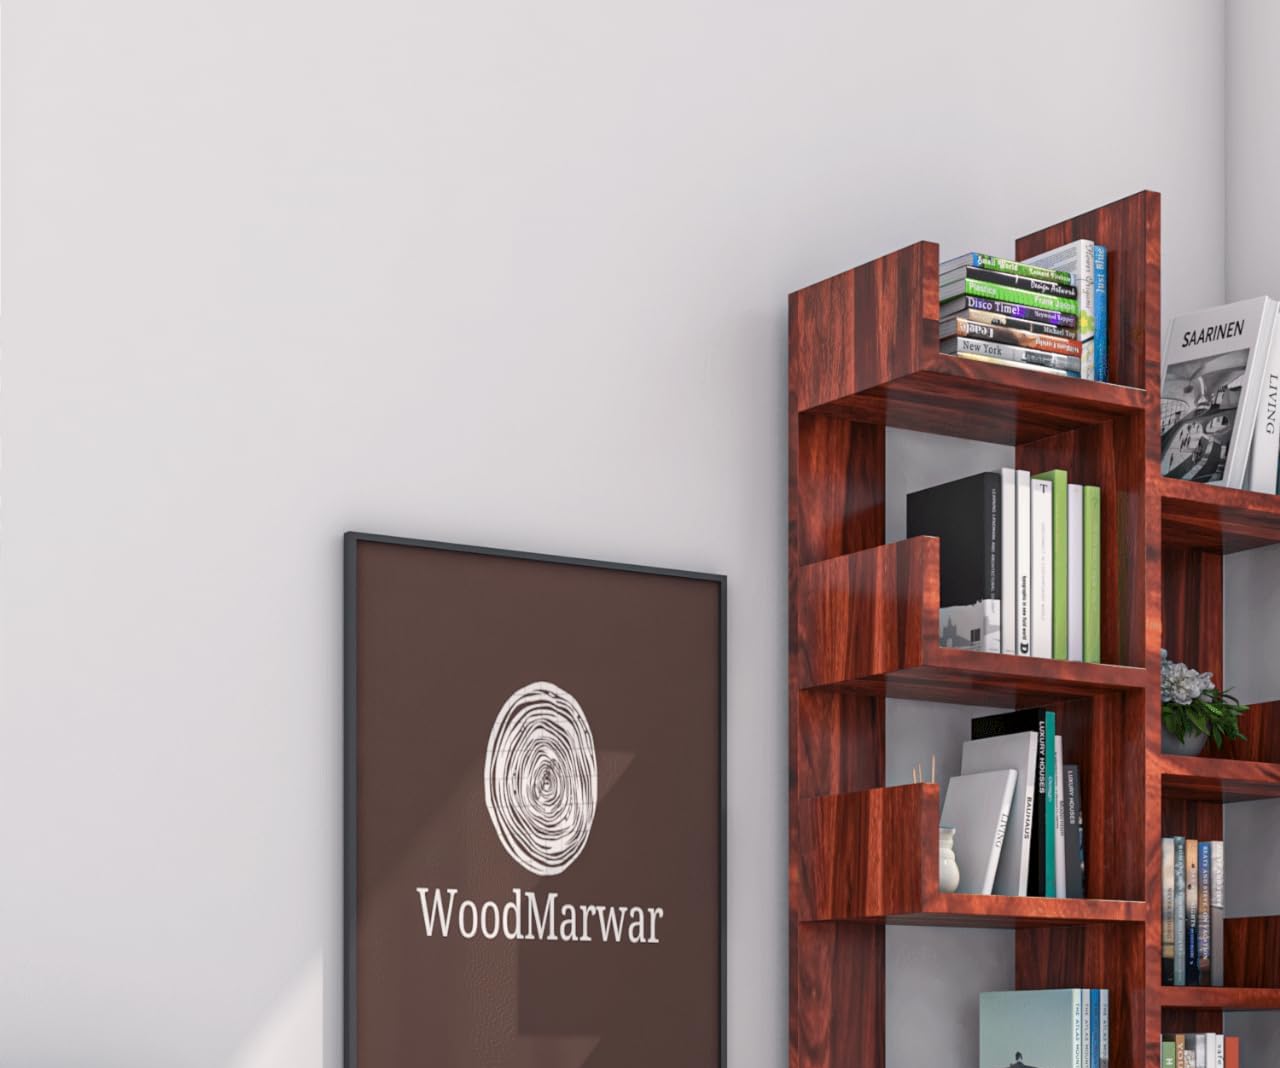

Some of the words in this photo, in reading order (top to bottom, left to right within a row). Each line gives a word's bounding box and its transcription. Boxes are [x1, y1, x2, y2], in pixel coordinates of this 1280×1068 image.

[967, 297, 993, 311] Disco
[994, 300, 1020, 316] Time!
[962, 340, 981, 352] New
[983, 343, 1003, 357] York
[1181, 319, 1246, 349] SAARINEN
[1265, 373, 1279, 435] LIVING
[995, 813, 1009, 848] LIVING
[416, 887, 664, 944] WoodMarwar
